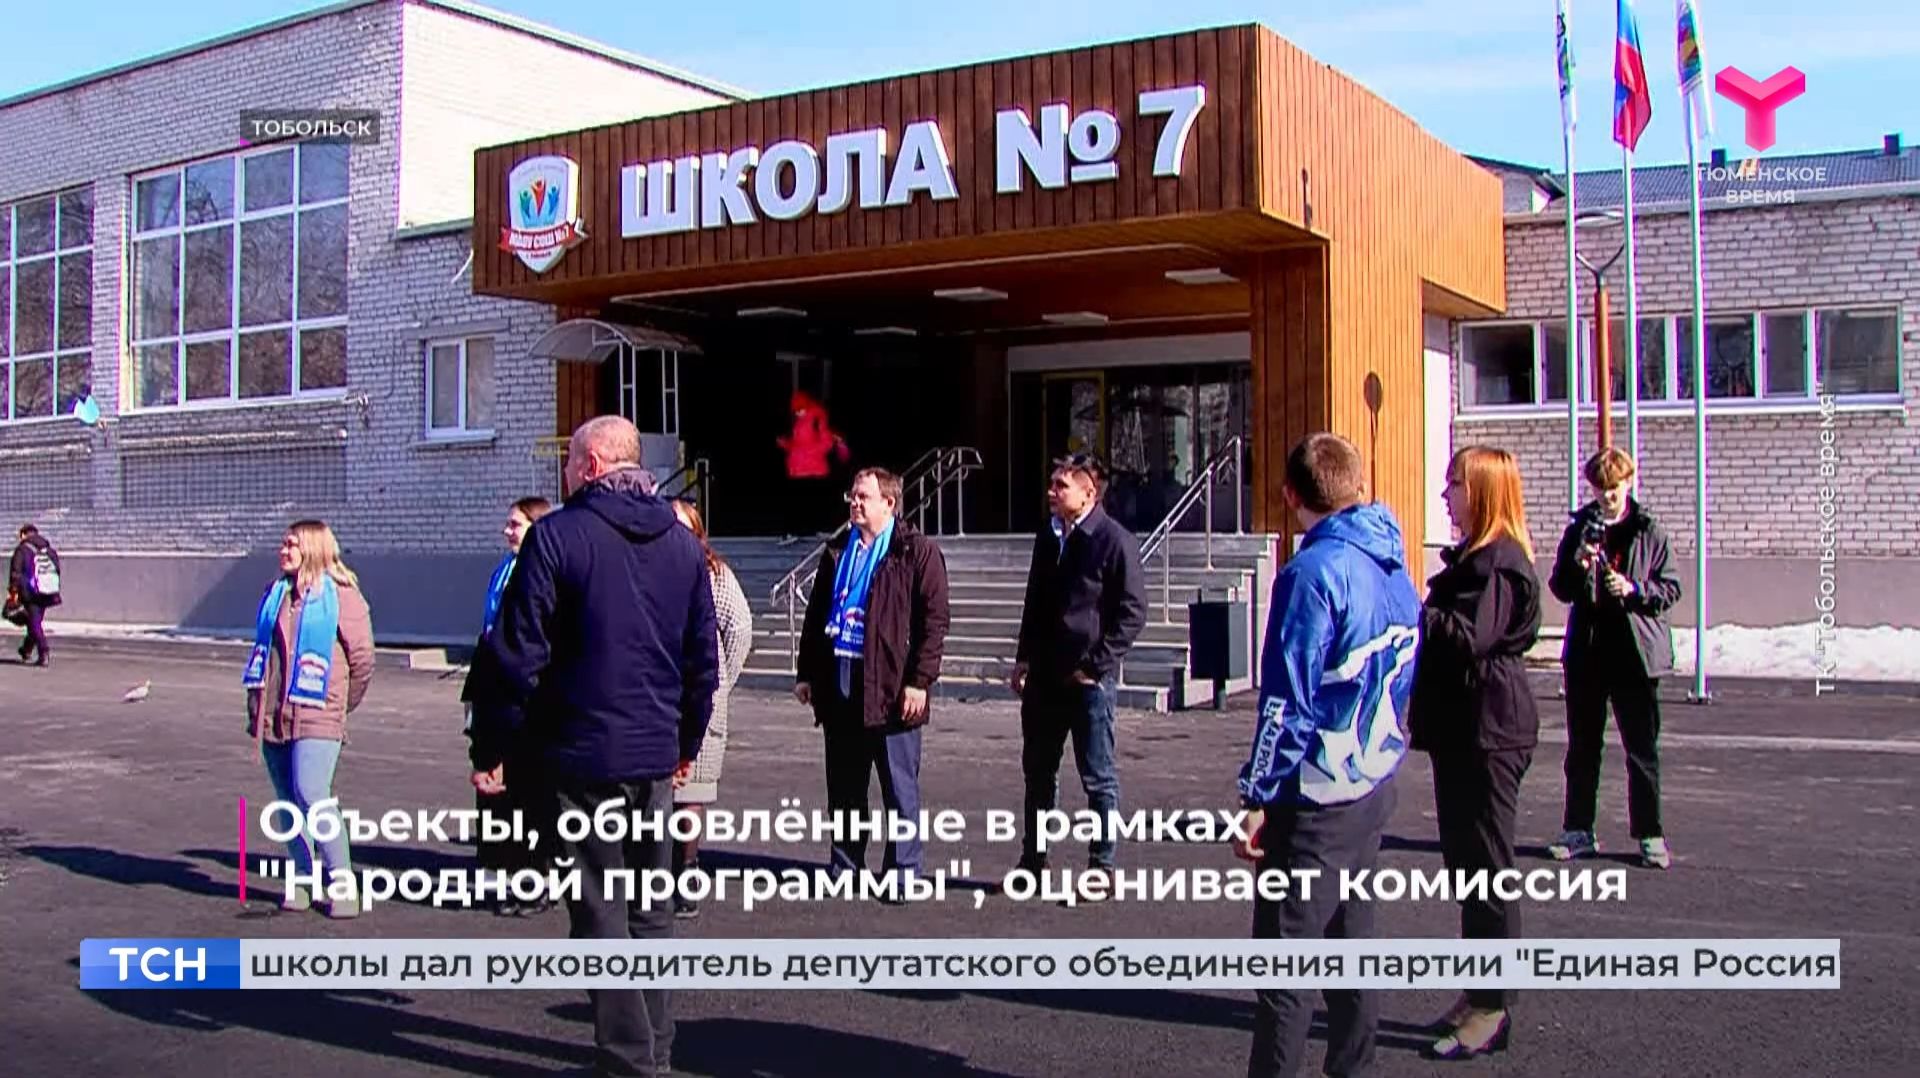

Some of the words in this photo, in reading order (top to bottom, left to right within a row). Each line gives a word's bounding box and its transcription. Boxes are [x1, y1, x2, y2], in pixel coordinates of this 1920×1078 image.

[621, 119, 958, 238] ШКОЛА
[996, 103, 1120, 193] №
[1138, 84, 1206, 177] 7
